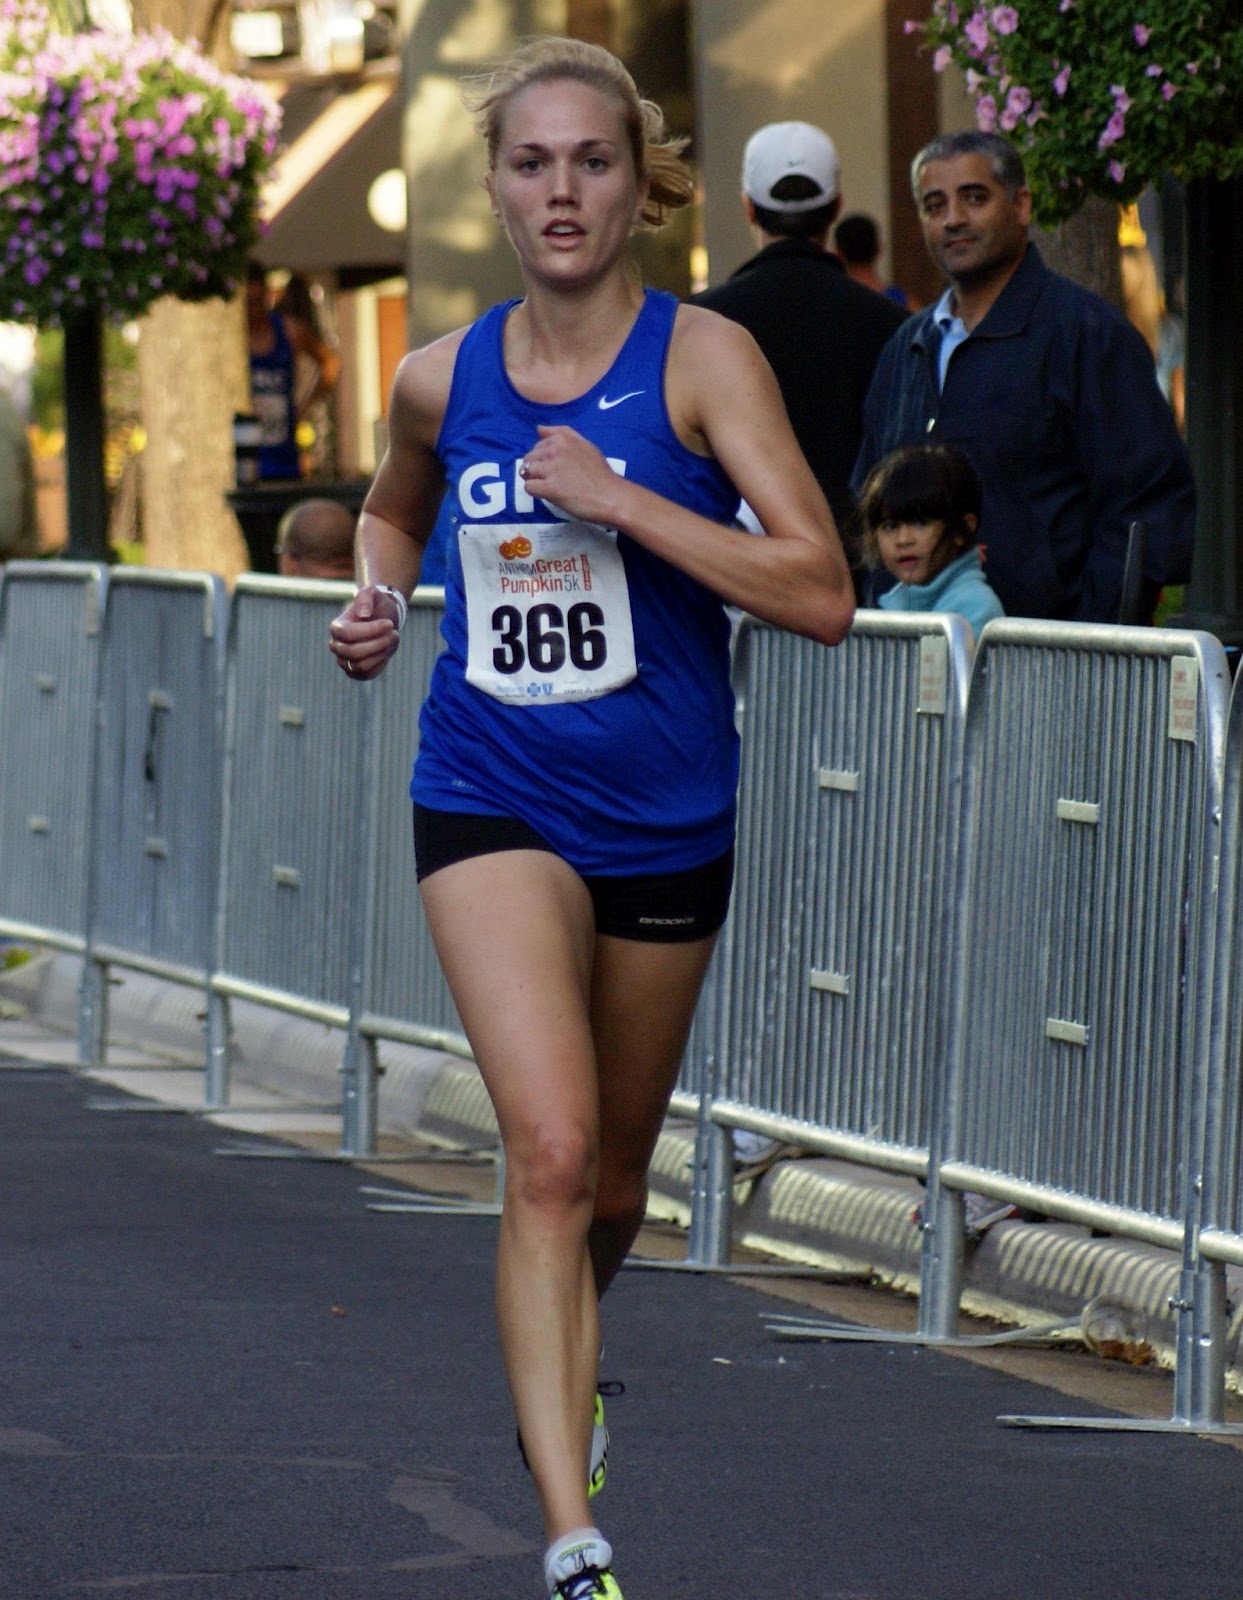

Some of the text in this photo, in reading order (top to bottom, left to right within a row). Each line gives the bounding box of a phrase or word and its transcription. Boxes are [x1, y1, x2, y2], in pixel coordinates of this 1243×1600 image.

[535, 556, 578, 573] Great
[501, 574, 563, 597] Pumpkin
[492, 602, 607, 674] 366
